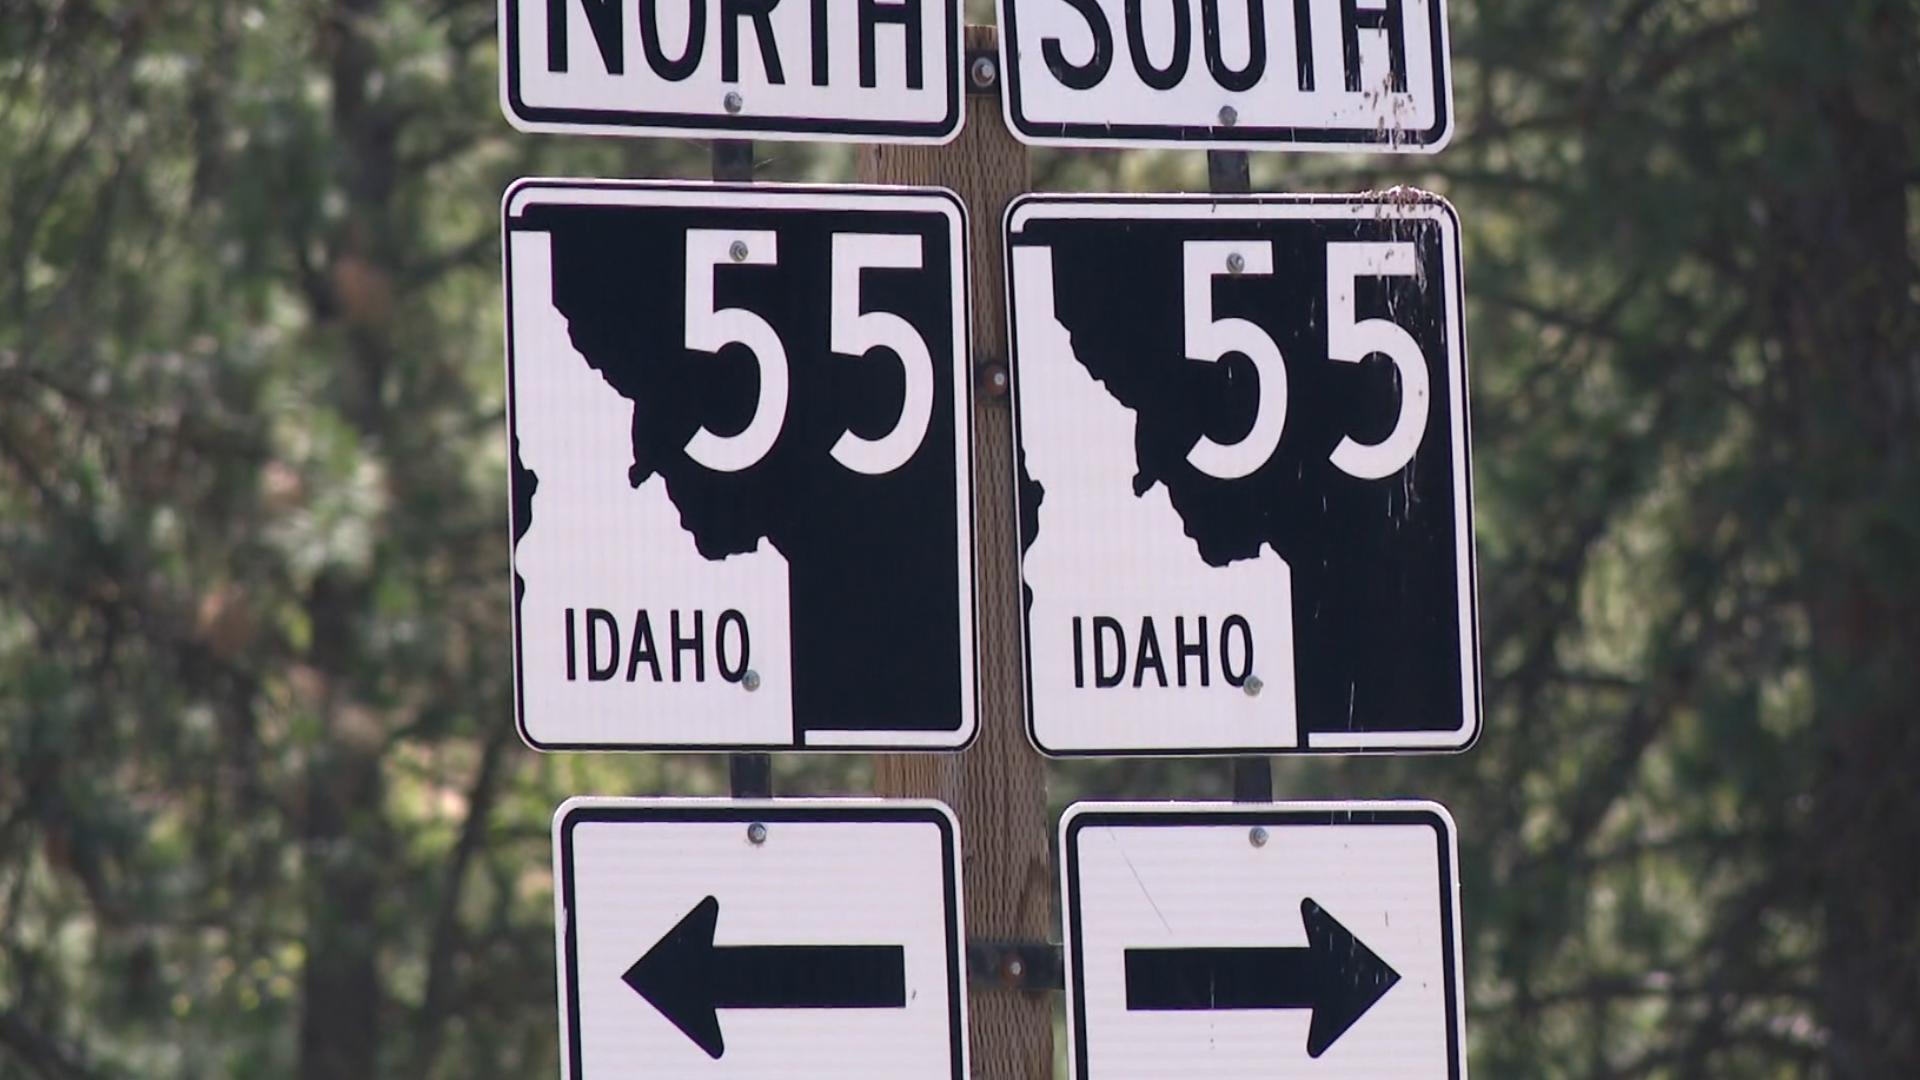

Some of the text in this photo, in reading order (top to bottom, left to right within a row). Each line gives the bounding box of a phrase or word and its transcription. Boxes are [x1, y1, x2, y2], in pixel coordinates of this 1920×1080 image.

[685, 230, 935, 475] 55
[1183, 239, 1430, 480] 55
[565, 608, 750, 684] IDAHO
[1073, 615, 1255, 689] IDAHO
